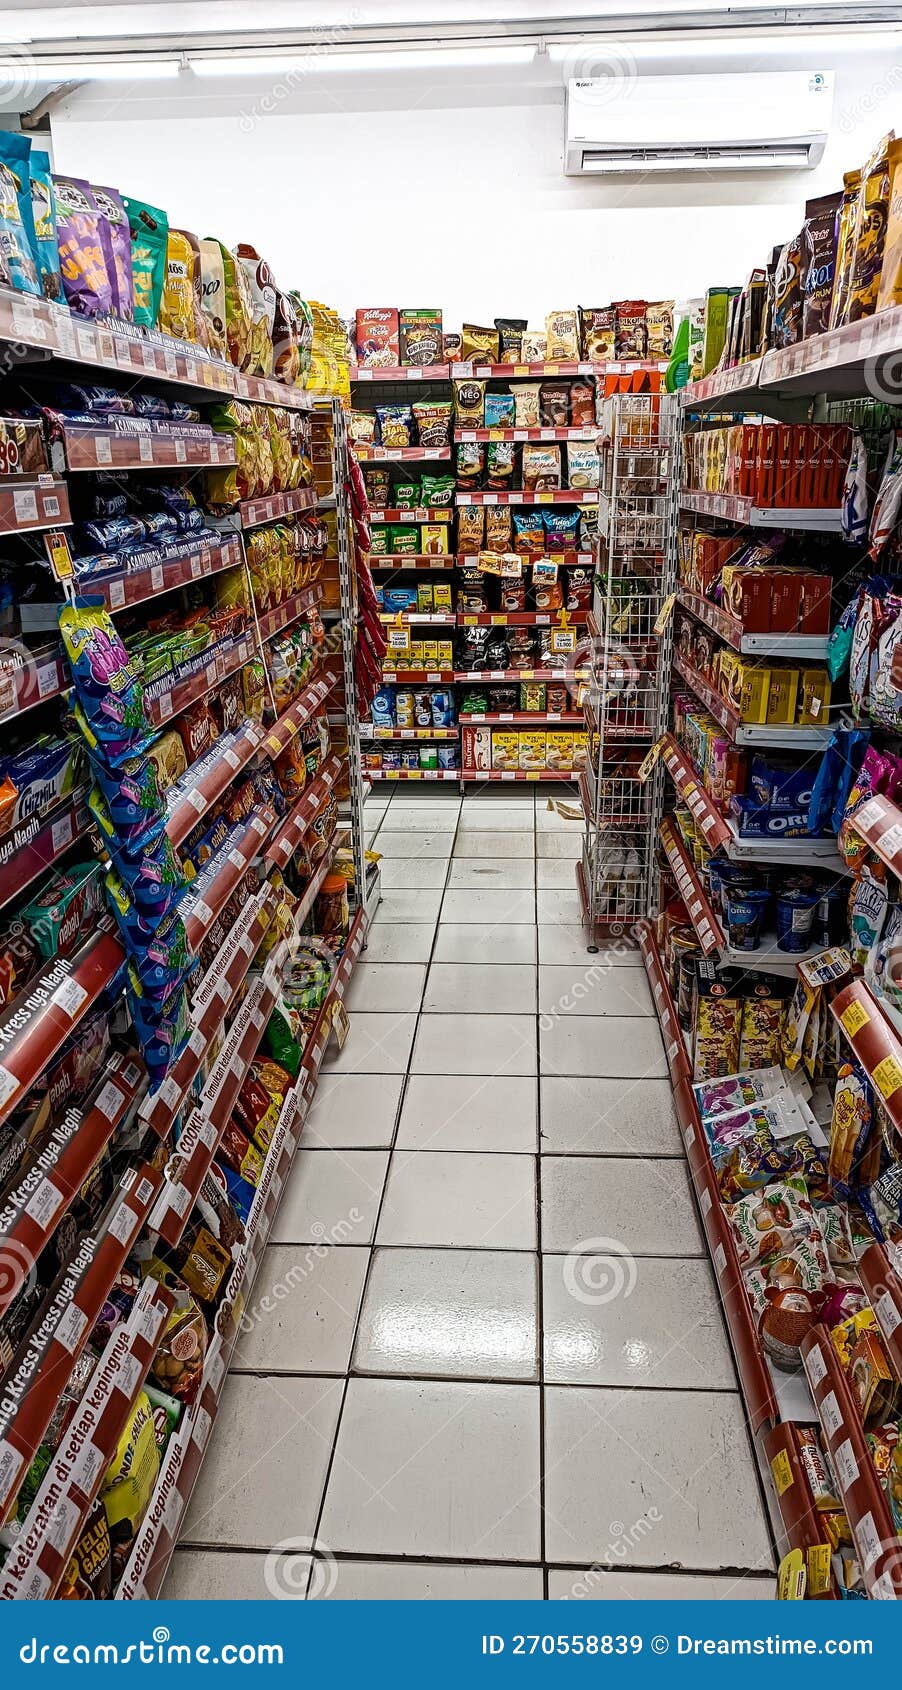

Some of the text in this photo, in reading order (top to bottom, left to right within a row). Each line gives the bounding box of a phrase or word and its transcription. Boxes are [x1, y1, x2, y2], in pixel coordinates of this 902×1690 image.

[13, 816, 41, 848] Nagih
[59, 911, 81, 944] nabati
[198, 972, 220, 1006] Temukan
[212, 943, 235, 981] kelezatan
[233, 920, 248, 945] setiap
[0, 1007, 32, 1043] Kress
[24, 986, 50, 1015] nya
[39, 957, 74, 994] Nagih
[205, 1069, 225, 1101] Temukan
[218, 1035, 240, 1075] kelezatan
[239, 1007, 252, 1032] setiap
[180, 1112, 205, 1154] COOKIE
[280, 1092, 299, 1135] kepingnya
[8, 1104, 84, 1207] Kress nya Nagih
[275, 1128, 287, 1156] setiap
[258, 1156, 276, 1199] kelezatan
[873, 1179, 899, 1208] mallow
[66, 1236, 98, 1278] Nagih
[228, 1249, 249, 1300] COOKIE
[58, 1278, 78, 1308] nya
[29, 1304, 61, 1350] Kress
[5, 1348, 40, 1398] Kress
[7, 1331, 131, 1582] kelezatan di setiap kepingnya
[807, 1446, 826, 1482] nutella
[130, 1529, 155, 1584] setiap
[150, 1442, 183, 1528] kepingnya
